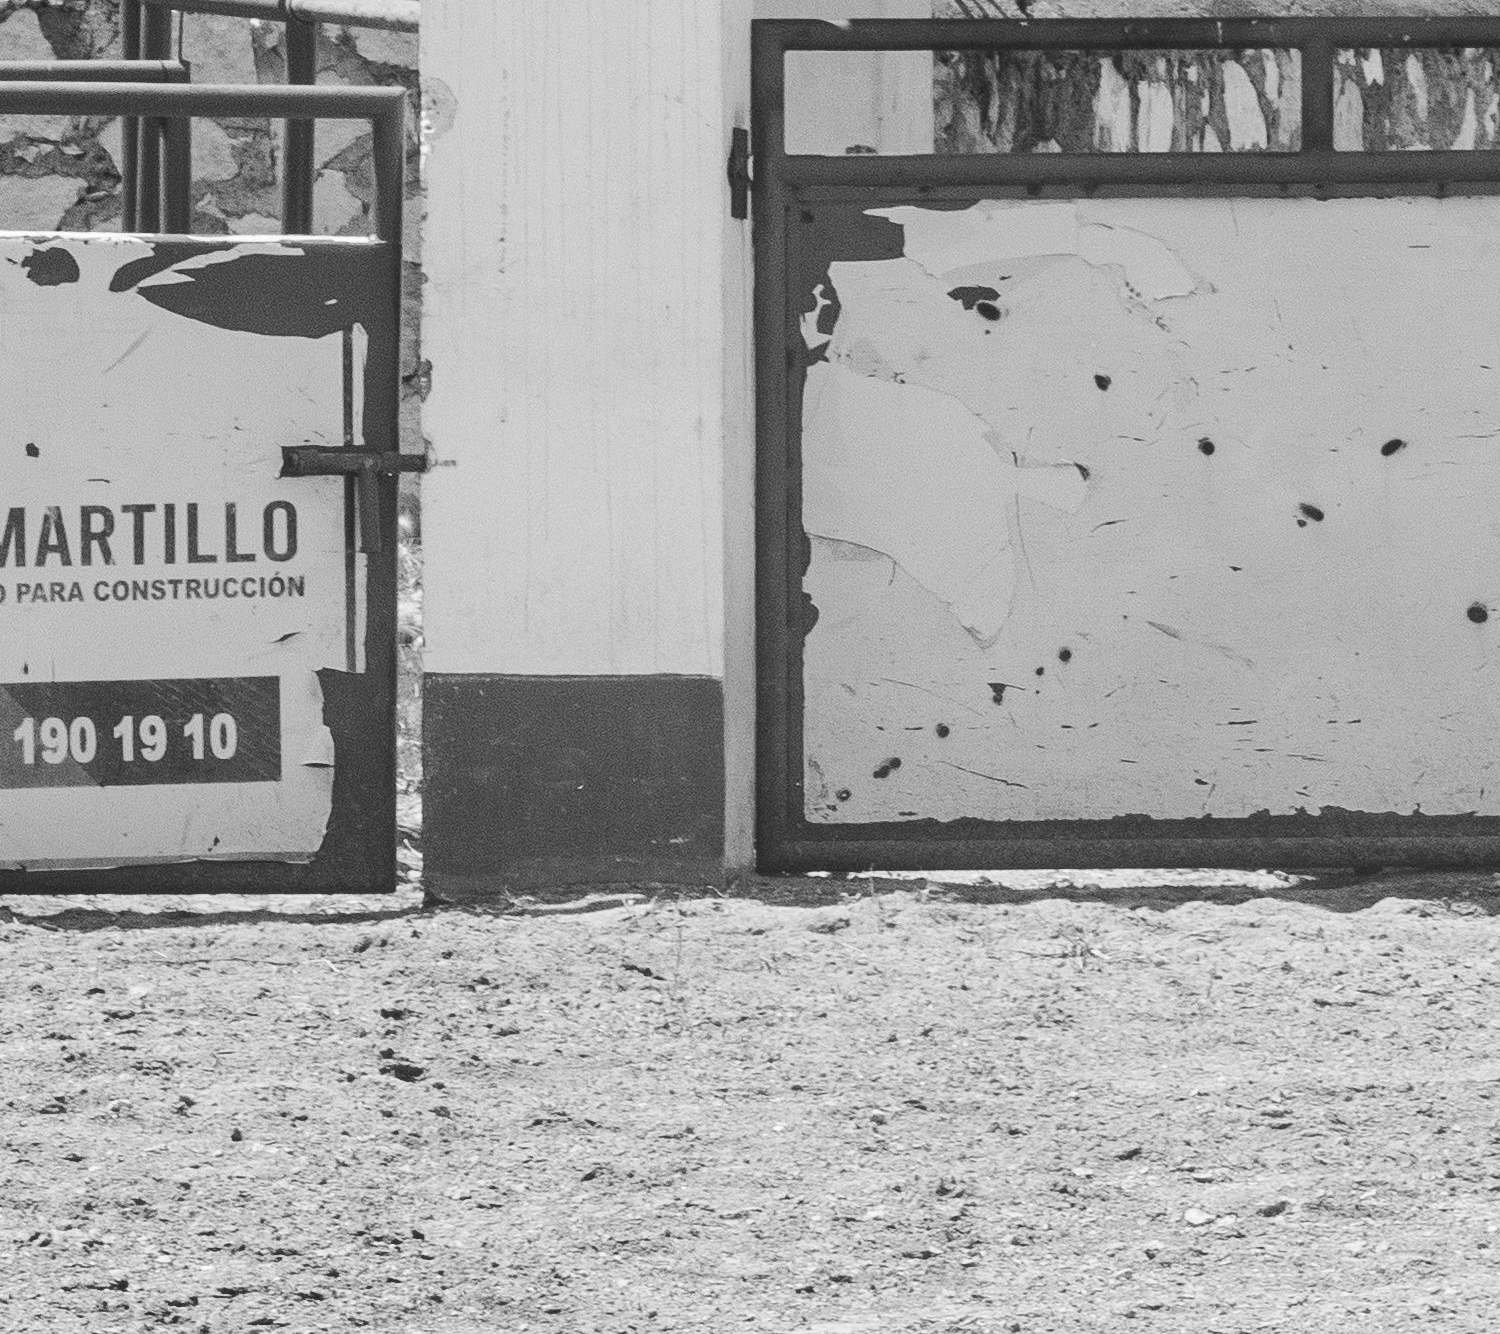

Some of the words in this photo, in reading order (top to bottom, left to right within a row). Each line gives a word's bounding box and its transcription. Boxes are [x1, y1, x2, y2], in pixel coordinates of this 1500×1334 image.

[16, 581, 84, 603] PARA
[93, 571, 305, 602] CONSTRUCCIÓN
[13, 716, 97, 765] 190
[113, 714, 168, 762] 19
[183, 712, 238, 760] 10
